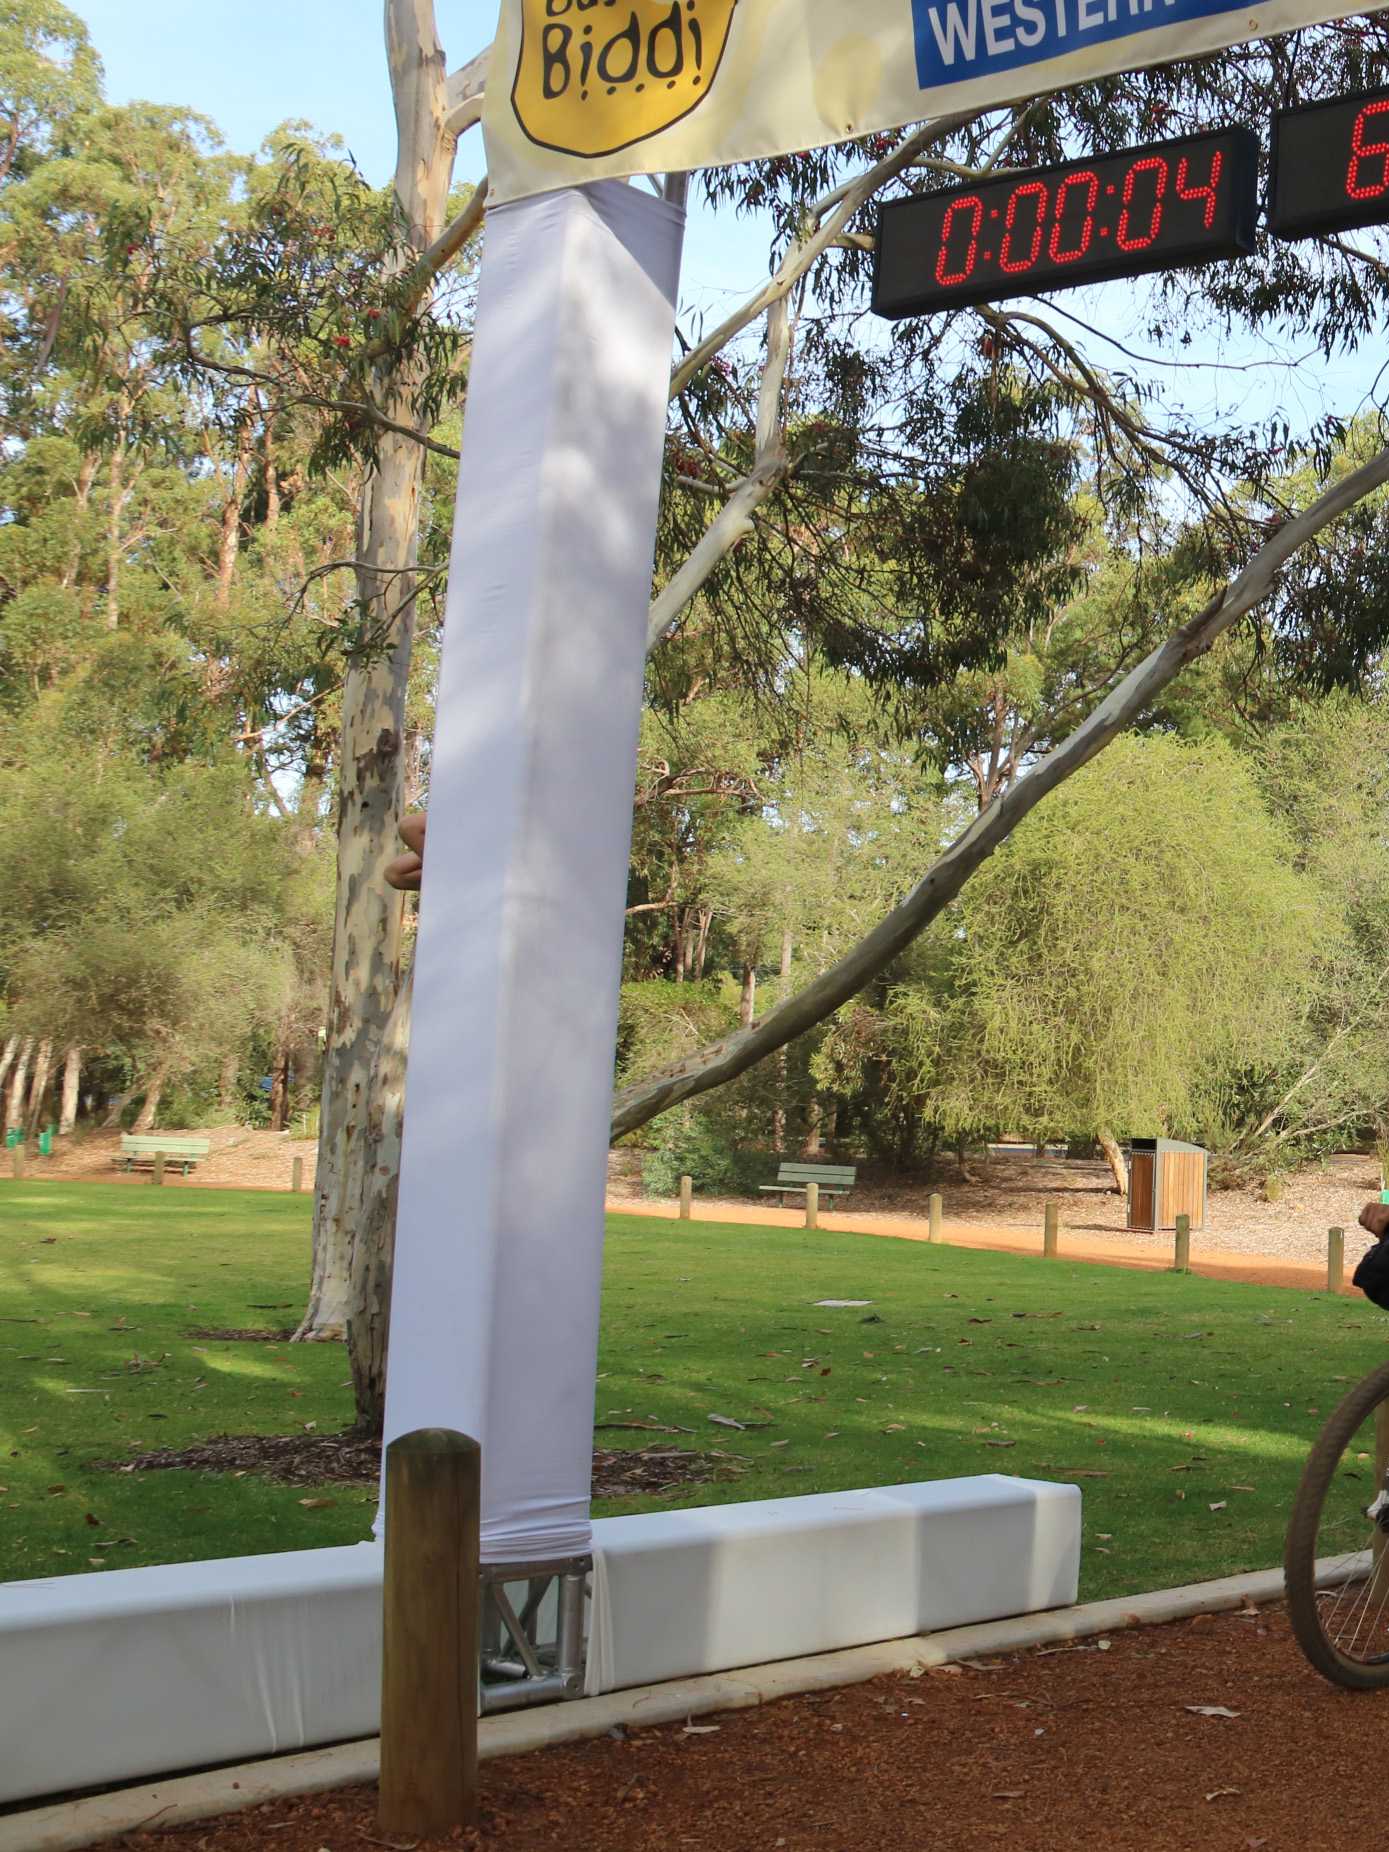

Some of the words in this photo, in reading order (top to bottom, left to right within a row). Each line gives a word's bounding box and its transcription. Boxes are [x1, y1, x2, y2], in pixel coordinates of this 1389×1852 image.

[542, 0, 702, 100] Biddi
[928, 0, 1175, 65] WESTE
[935, 150, 1222, 287] 0:00:04
